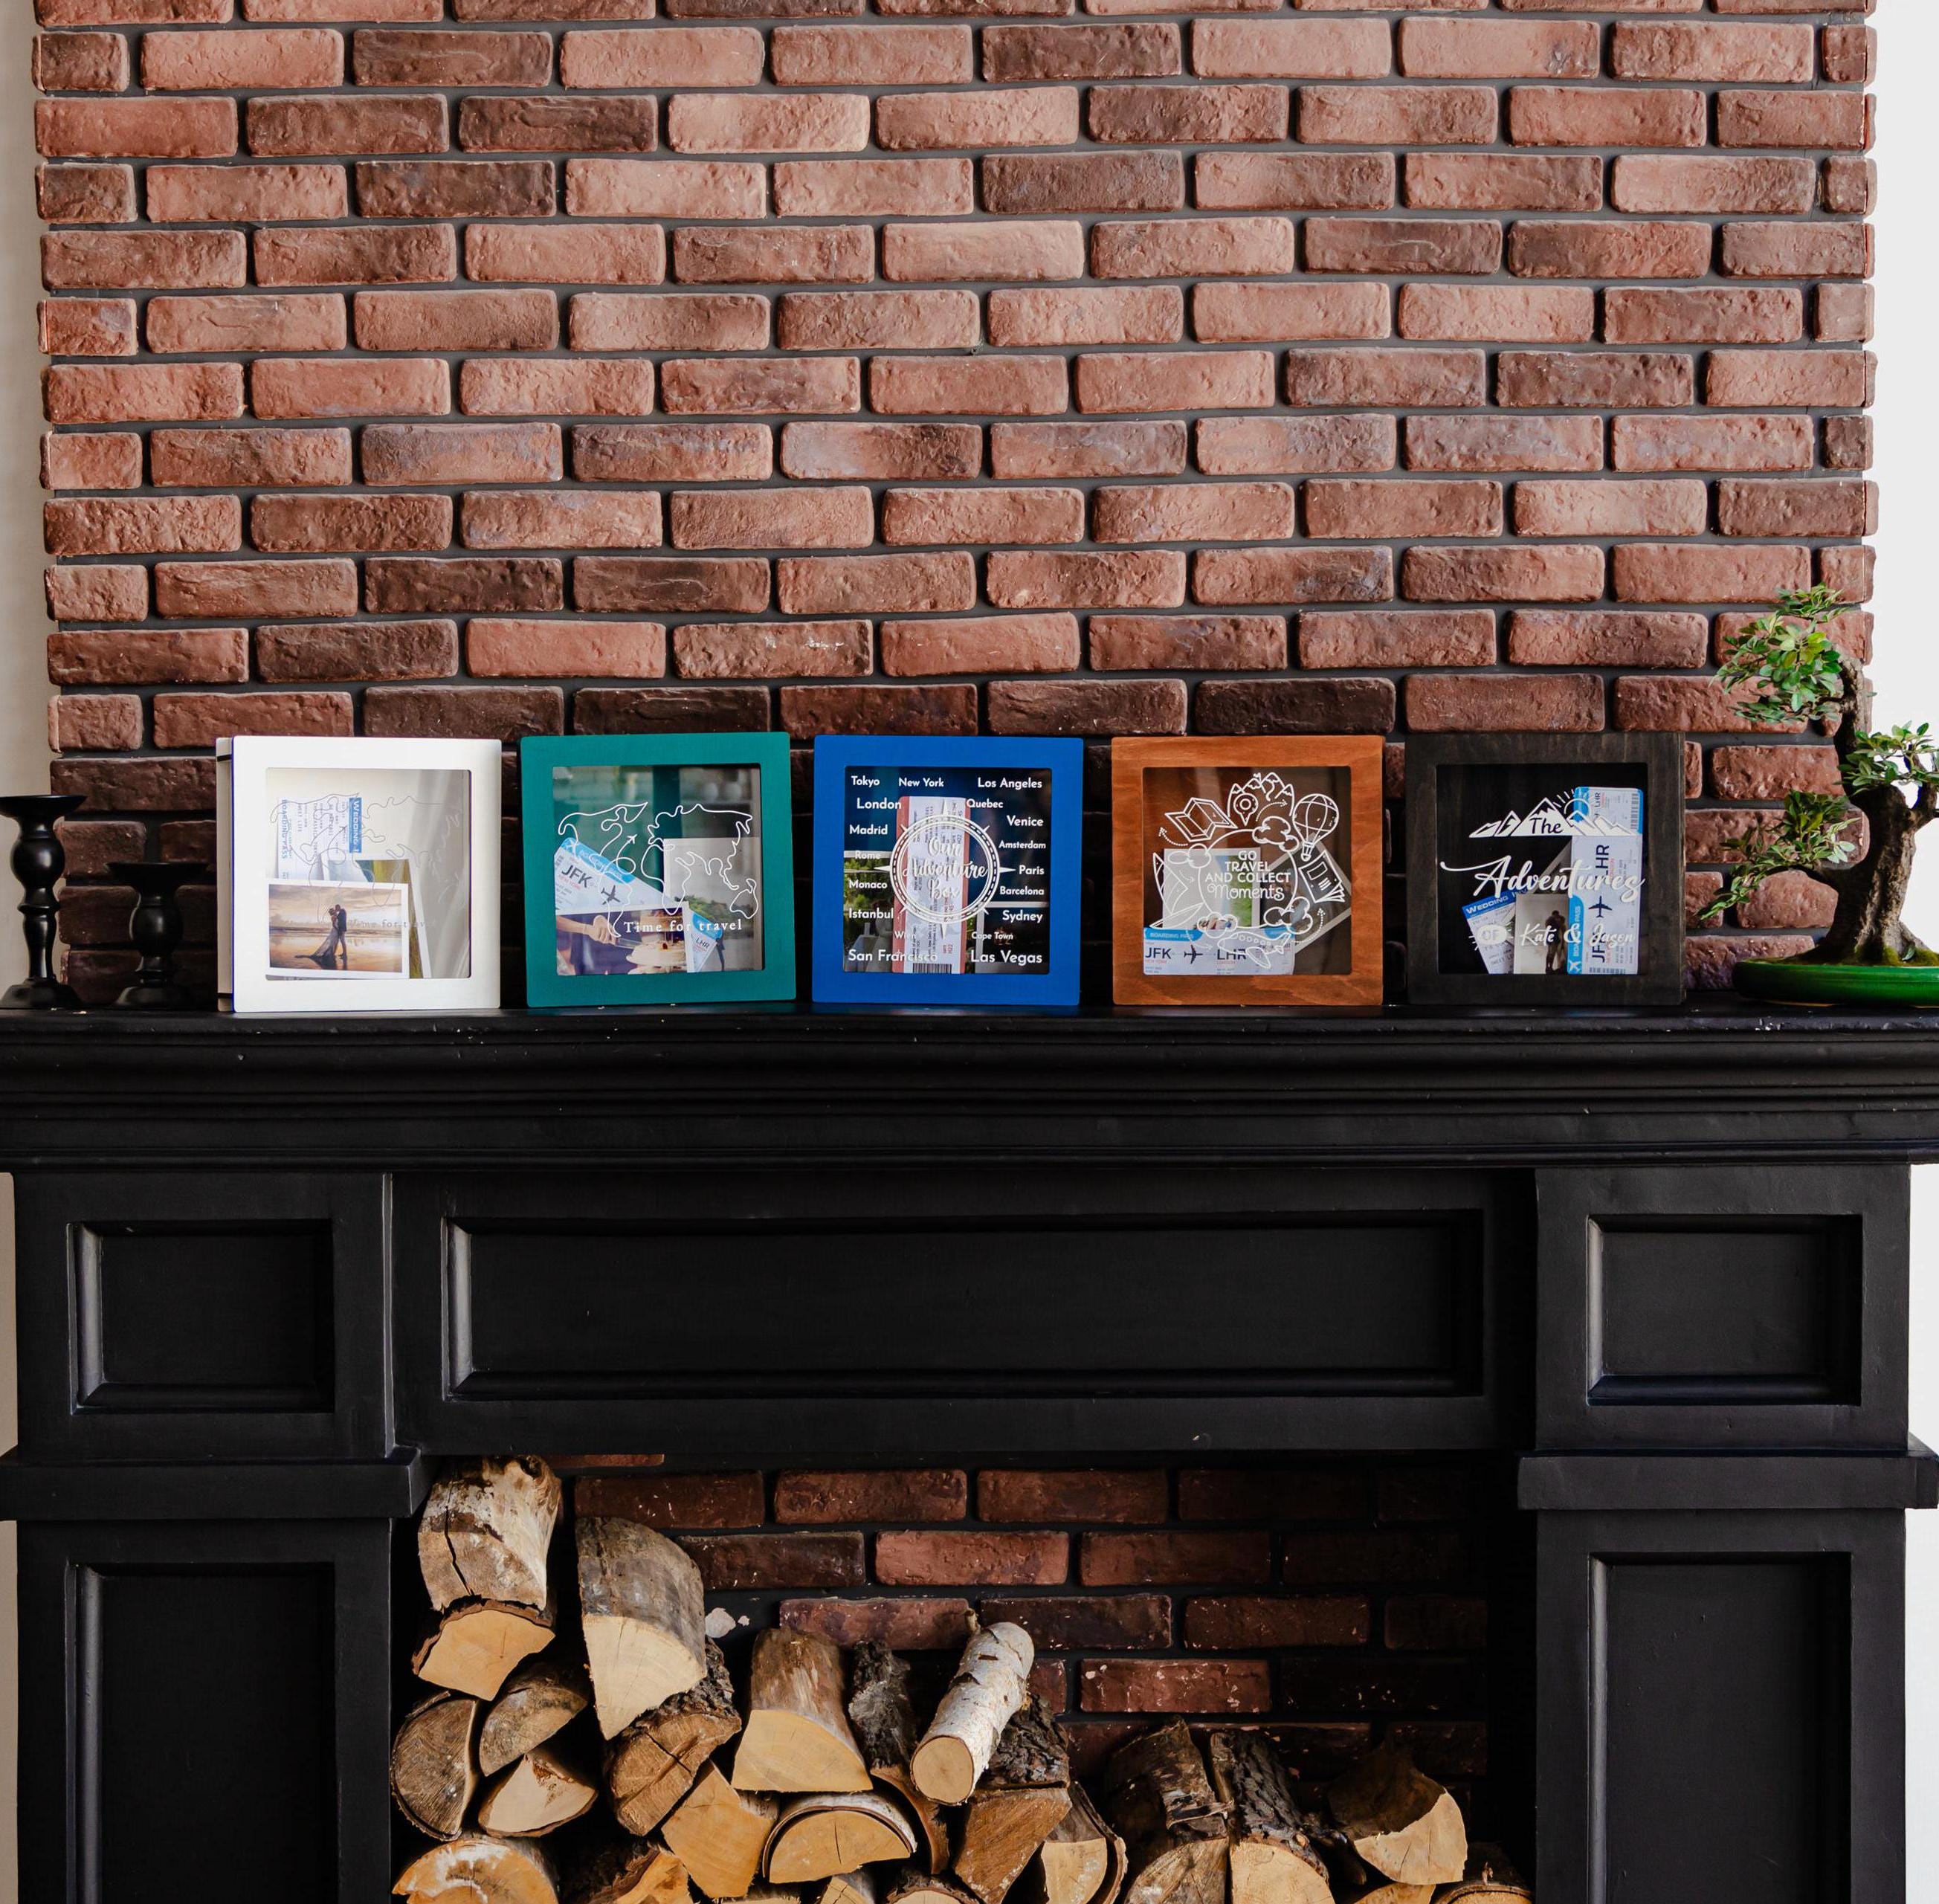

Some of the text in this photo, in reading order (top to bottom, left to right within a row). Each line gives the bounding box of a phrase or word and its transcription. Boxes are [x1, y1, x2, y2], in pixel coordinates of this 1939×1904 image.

[851, 775, 880, 787] Tokyo
[898, 777, 944, 787] New York
[978, 777, 1042, 790] Los Angeles
[856, 797, 901, 809] London
[967, 798, 1004, 808] Quebec
[1006, 815, 1044, 826] Venice
[1529, 817, 1563, 834] The
[849, 824, 888, 835] Madrid
[998, 839, 1046, 848] Amsterdam
[855, 850, 881, 859] Rome
[1238, 850, 1257, 861] GO
[902, 856, 987, 879] Adventure
[1019, 865, 1045, 875] Paris
[1225, 861, 1271, 872] TRAVEL
[561, 865, 593, 888] JFK
[1204, 872, 1291, 882] AND COLLECT
[1440, 855, 1645, 903] Adventures
[848, 880, 888, 888] Monaco
[928, 879, 961, 899] Box
[999, 885, 1045, 895] Barcelona
[1465, 895, 1509, 914] WEDDING
[848, 907, 894, 919] Istanbul
[1002, 909, 1043, 923] Sydney
[623, 919, 742, 933] Time for travel
[971, 931, 1013, 941] Cape Town
[1482, 923, 1633, 948] OF Kate & Jason
[848, 949, 872, 961] San
[878, 949, 938, 961] Francisco
[971, 949, 1042, 966] Las Vegas
[1145, 947, 1247, 961] JFK LHR
